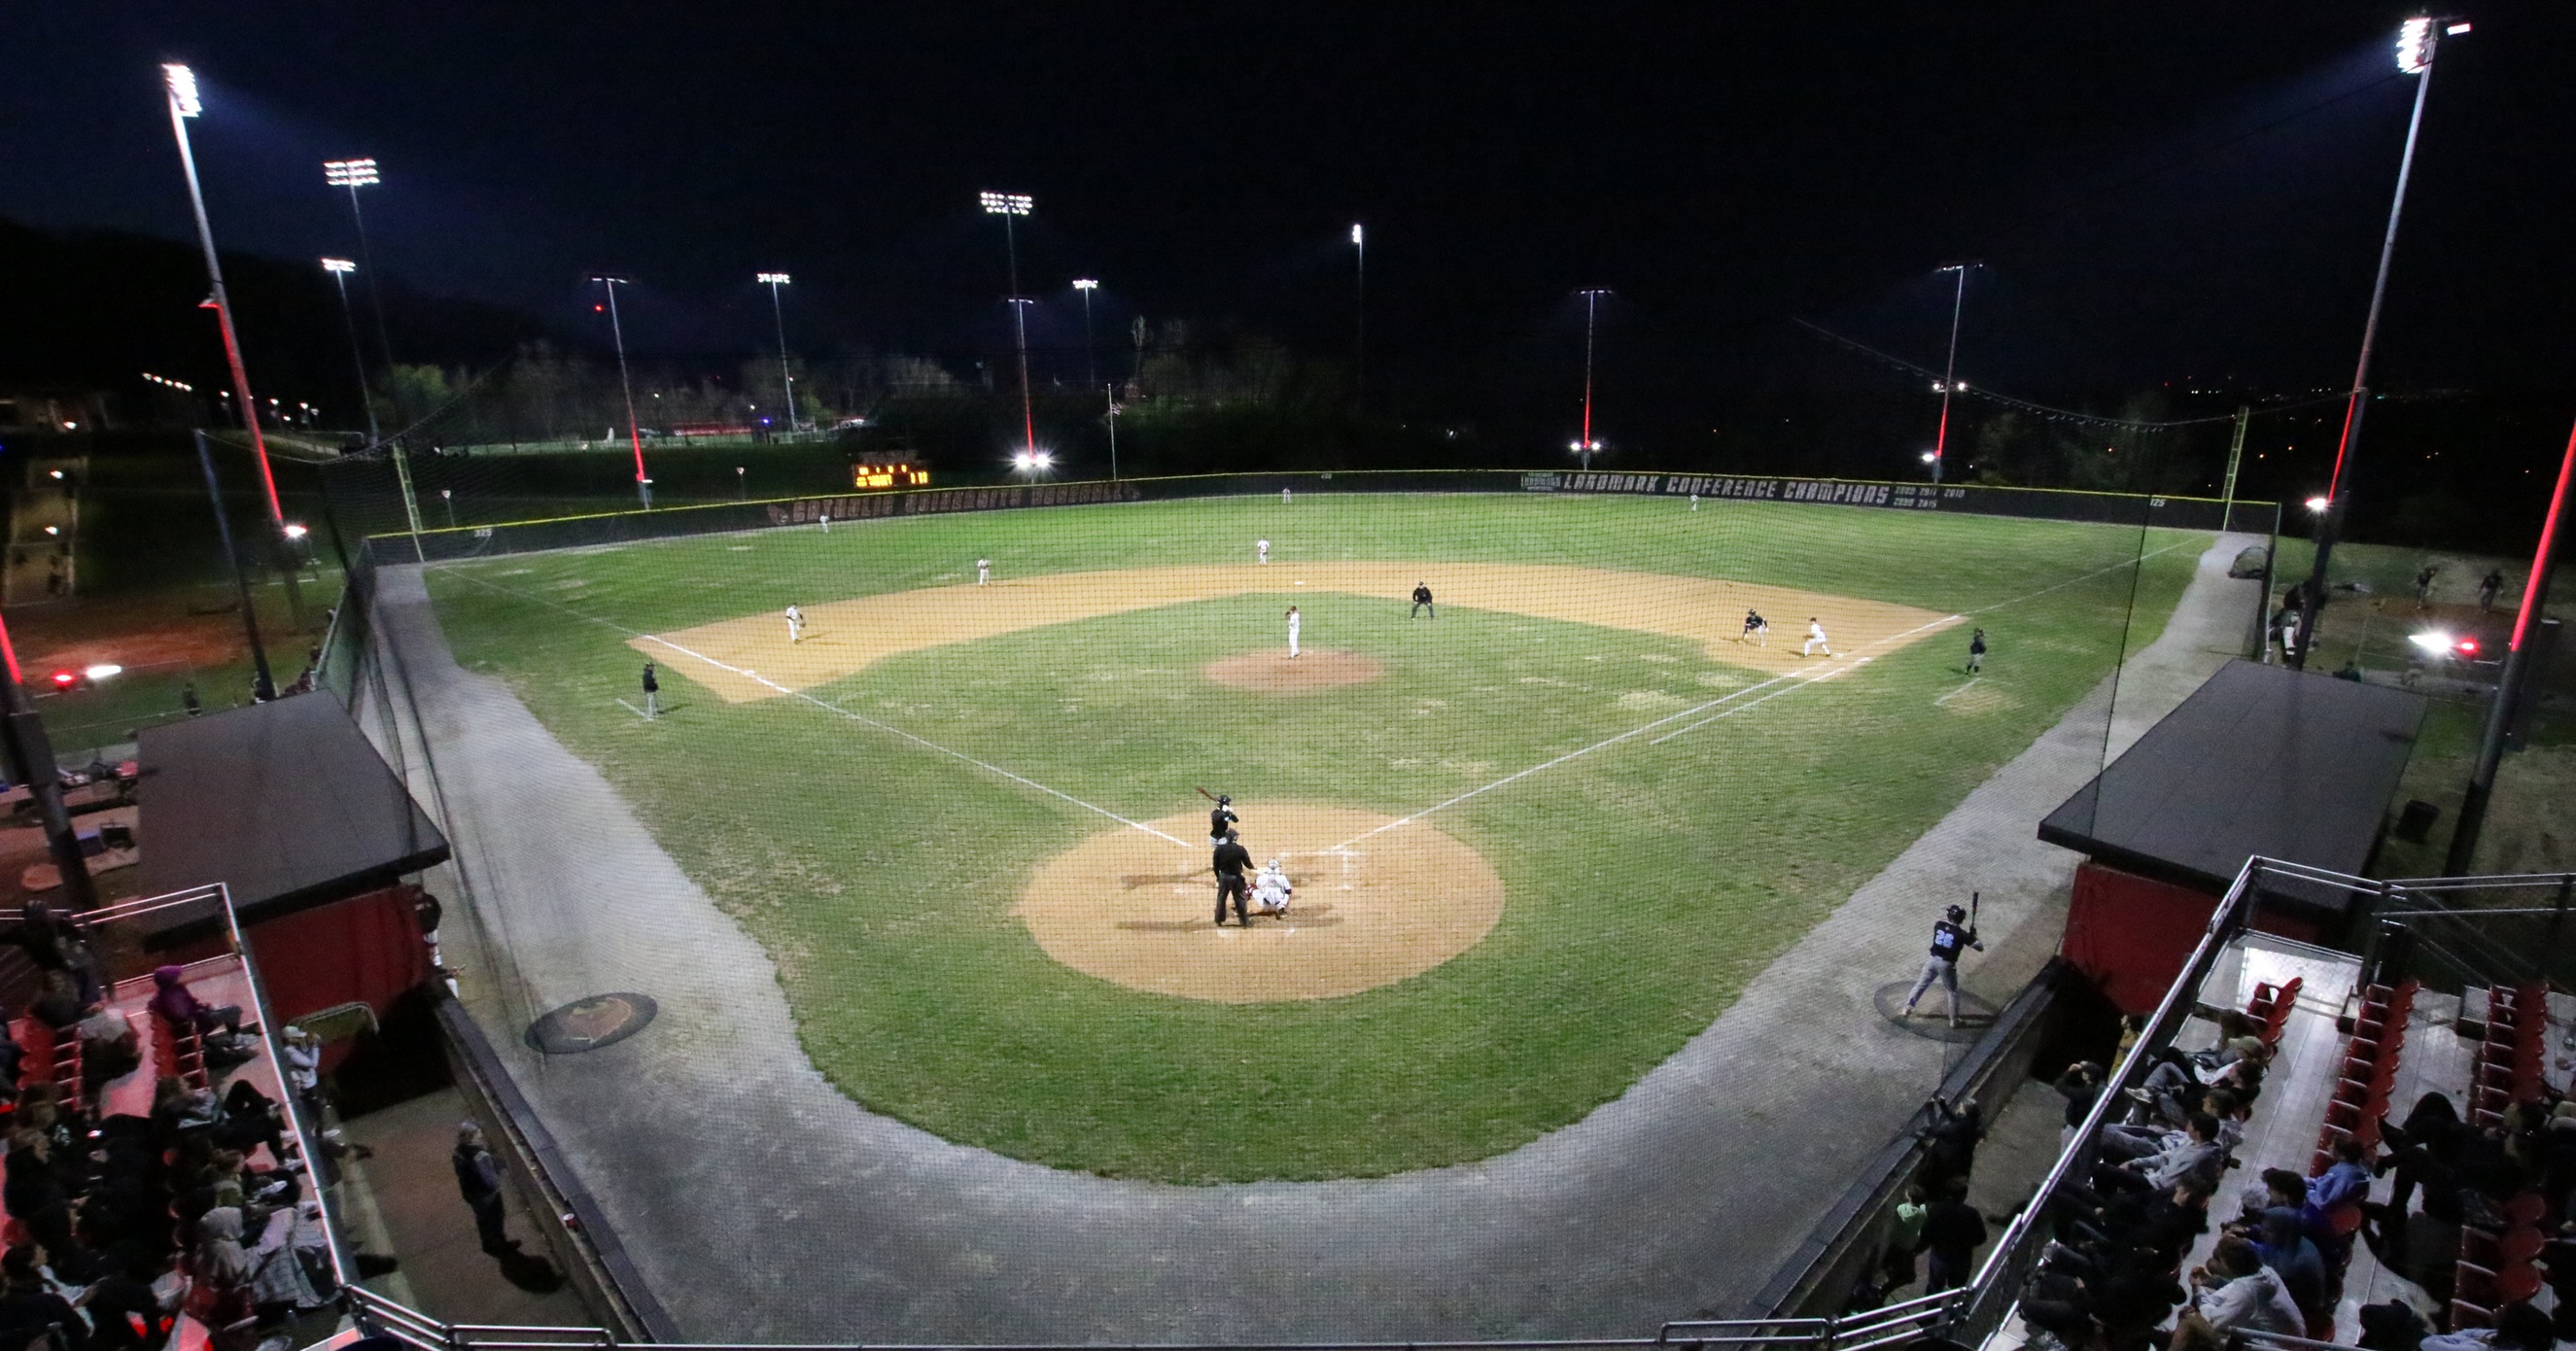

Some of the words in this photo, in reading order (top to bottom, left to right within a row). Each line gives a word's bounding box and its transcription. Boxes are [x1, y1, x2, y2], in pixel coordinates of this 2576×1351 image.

[1564, 473, 1660, 492] LANDMARK
[1666, 477, 1776, 498] CONFERENCE
[1784, 482, 1889, 504] CHAMPIONS
